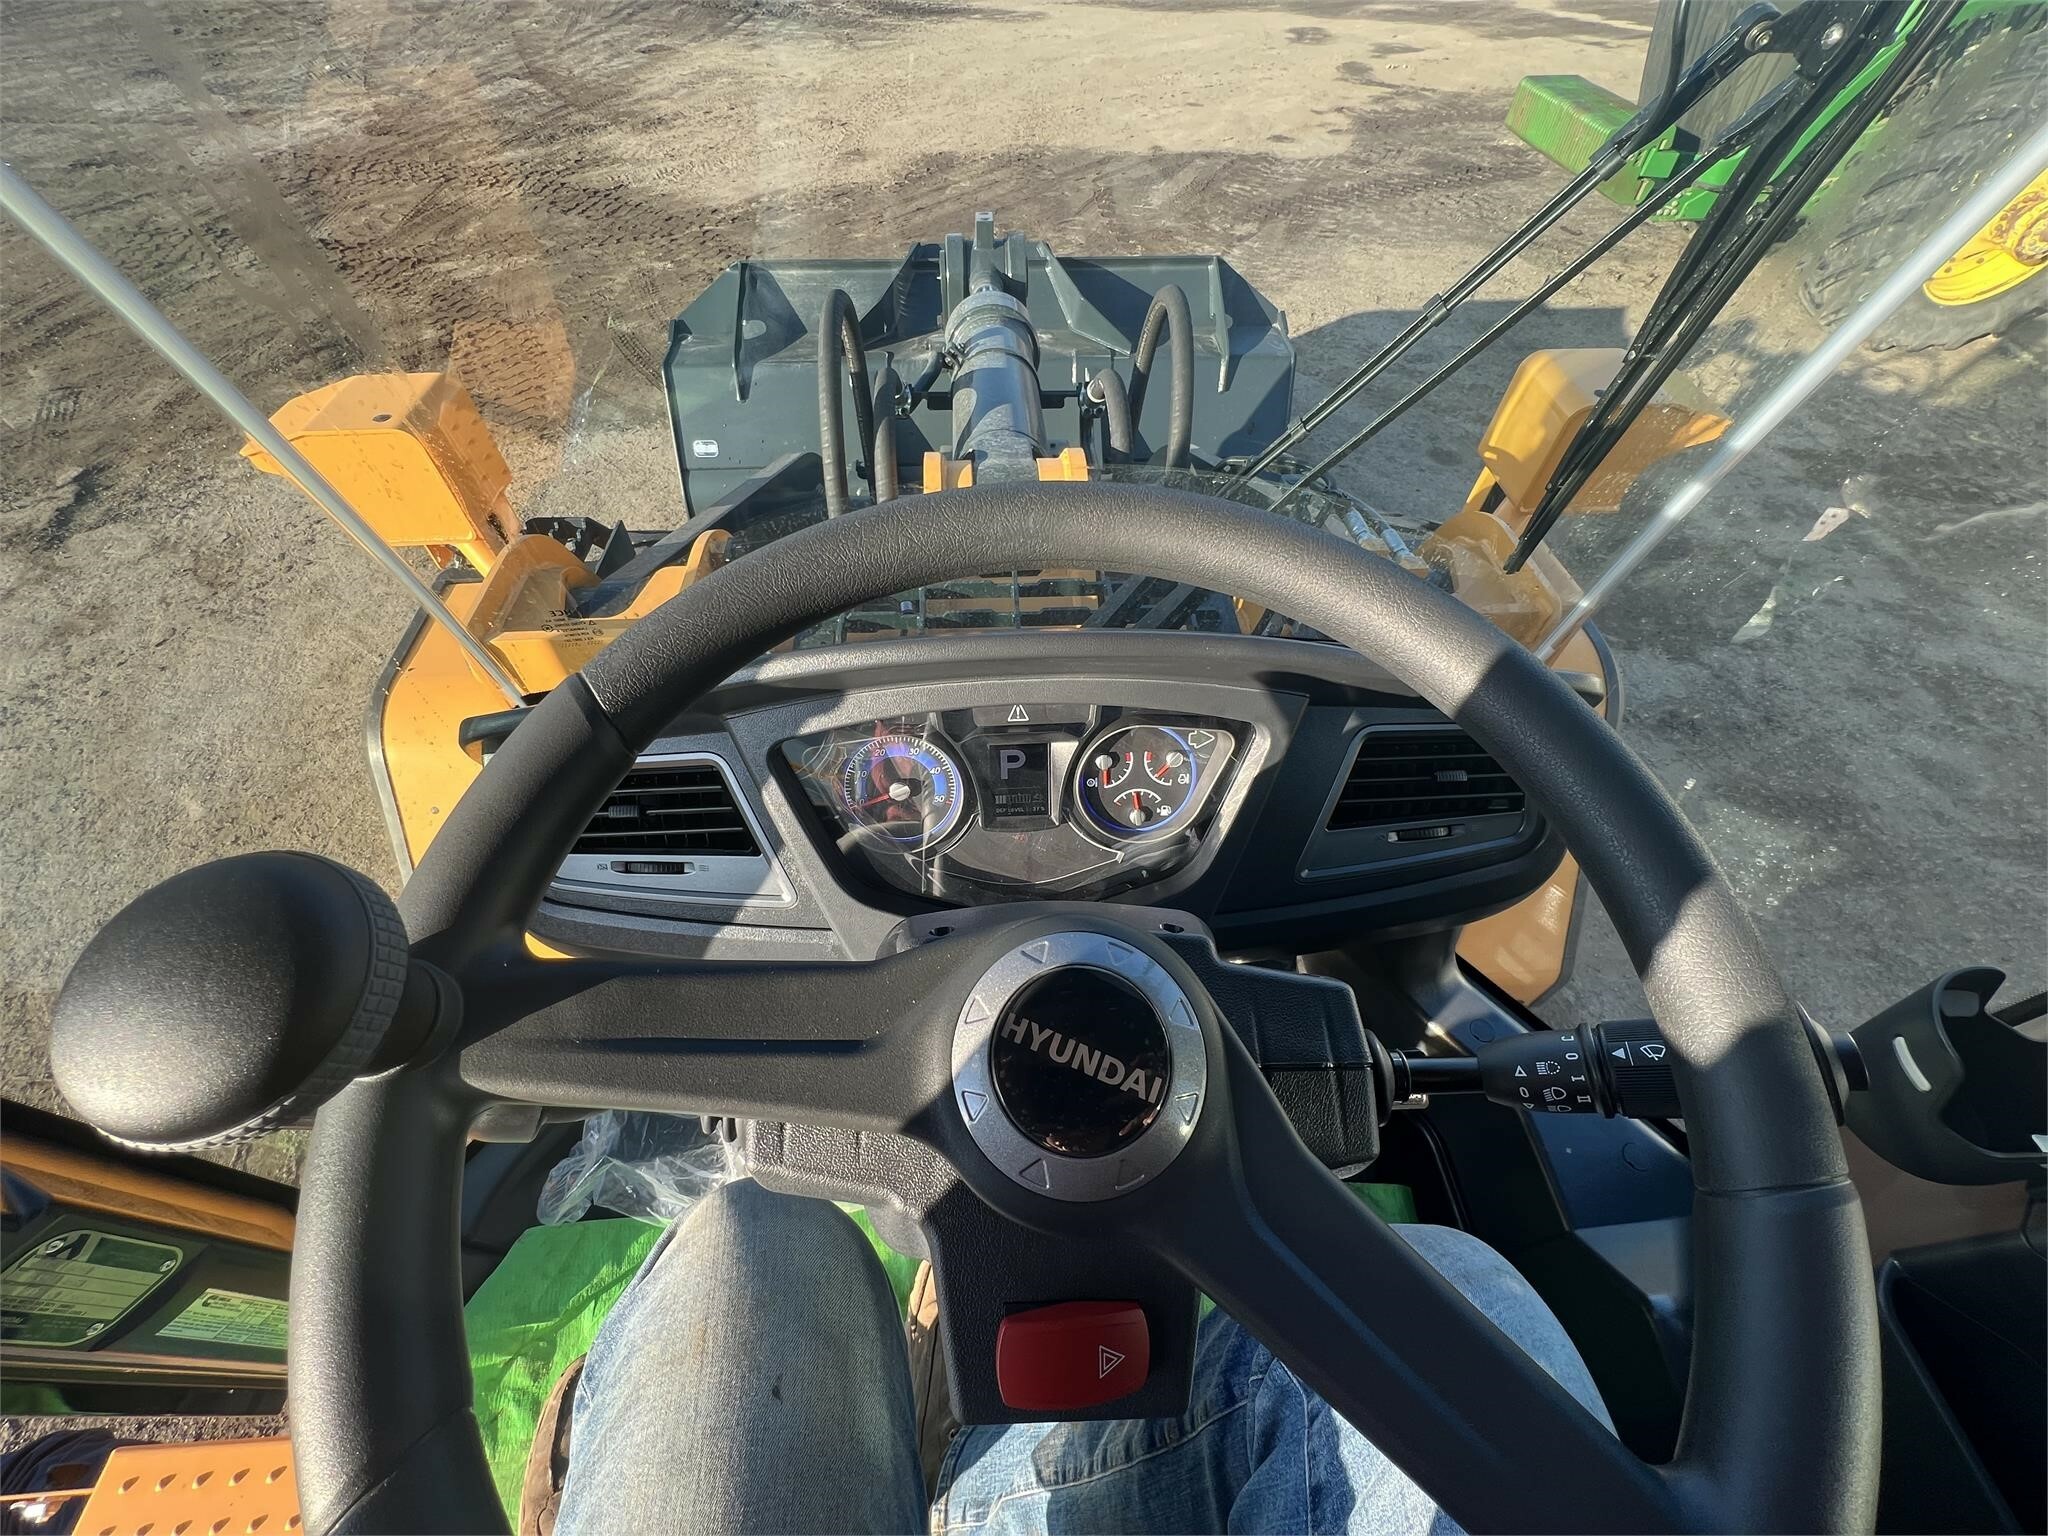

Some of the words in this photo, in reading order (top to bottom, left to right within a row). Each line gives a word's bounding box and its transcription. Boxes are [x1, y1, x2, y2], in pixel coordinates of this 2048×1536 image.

[874, 749, 886, 757] 20
[999, 749, 1026, 780] P
[934, 795, 945, 803] 50
[1001, 1012, 1163, 1103] HYUNDAI
